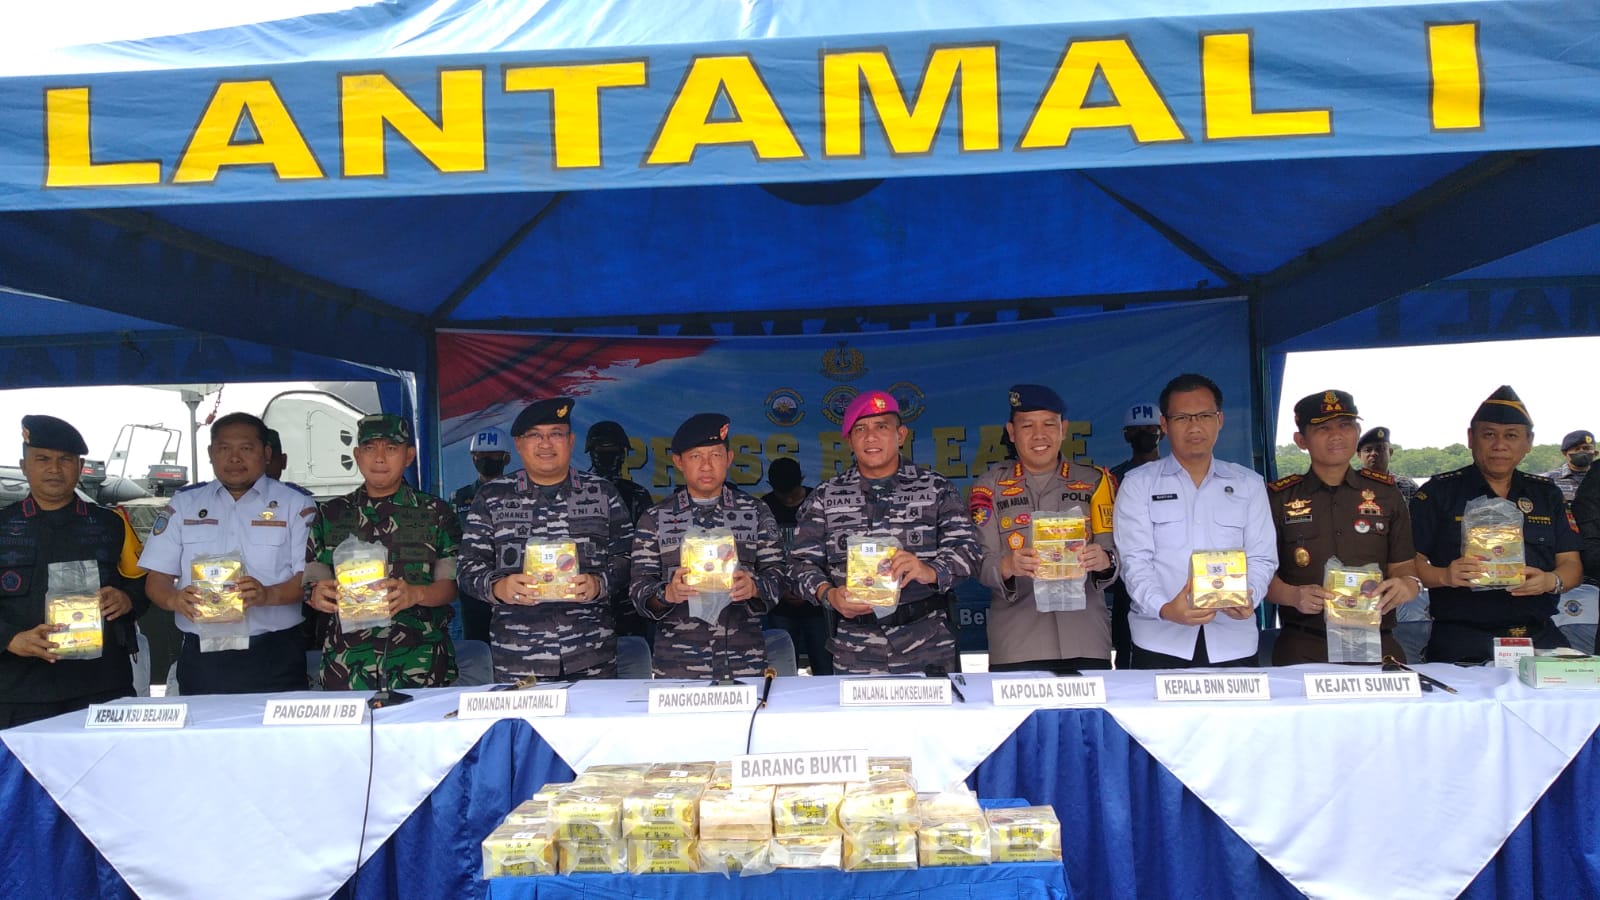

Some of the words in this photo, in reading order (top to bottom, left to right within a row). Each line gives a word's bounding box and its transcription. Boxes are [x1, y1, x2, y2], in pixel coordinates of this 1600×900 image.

[44, 28, 1334, 188] LANTAMAL
[1426, 21, 1486, 132] I
[1132, 406, 1154, 420] PM
[478, 432, 498, 446] PM
[622, 433, 800, 486] PRSS
[819, 421, 1093, 480] RLEAE
[826, 497, 851, 506] DIAN
[855, 497, 862, 505] S
[918, 493, 933, 501] AL
[1061, 492, 1091, 503] POLR
[496, 511, 529, 521] JOHANES
[571, 508, 589, 516] TNI
[593, 507, 605, 516] AL
[661, 537, 682, 546] ARSY
[746, 533, 757, 542] AL
[1212, 565, 1222, 573] 35
[852, 685, 889, 701] DANLANAL
[890, 684, 944, 701] LHOKSEUMAWE
[1001, 683, 1054, 699] KAPOLDA
[1056, 682, 1097, 698] SUMUT
[1165, 679, 1202, 695] KEPALA
[1204, 679, 1225, 695] BNN
[1227, 678, 1261, 694] SUMUT
[1315, 678, 1361, 693] KEJATI
[1365, 677, 1411, 692] SUMUT
[467, 696, 511, 712] KOMANDAN
[512, 695, 554, 711] LANTAMAL
[658, 691, 744, 707] PANGKOARMADA
[95, 709, 124, 723] KEPALA
[124, 709, 141, 723] KSU
[142, 707, 181, 722] BELAWAN
[272, 705, 330, 719] PANGDAM
[332, 704, 357, 718] I/BB
[741, 758, 805, 778] BARANG
[809, 755, 857, 775] BUKTI
